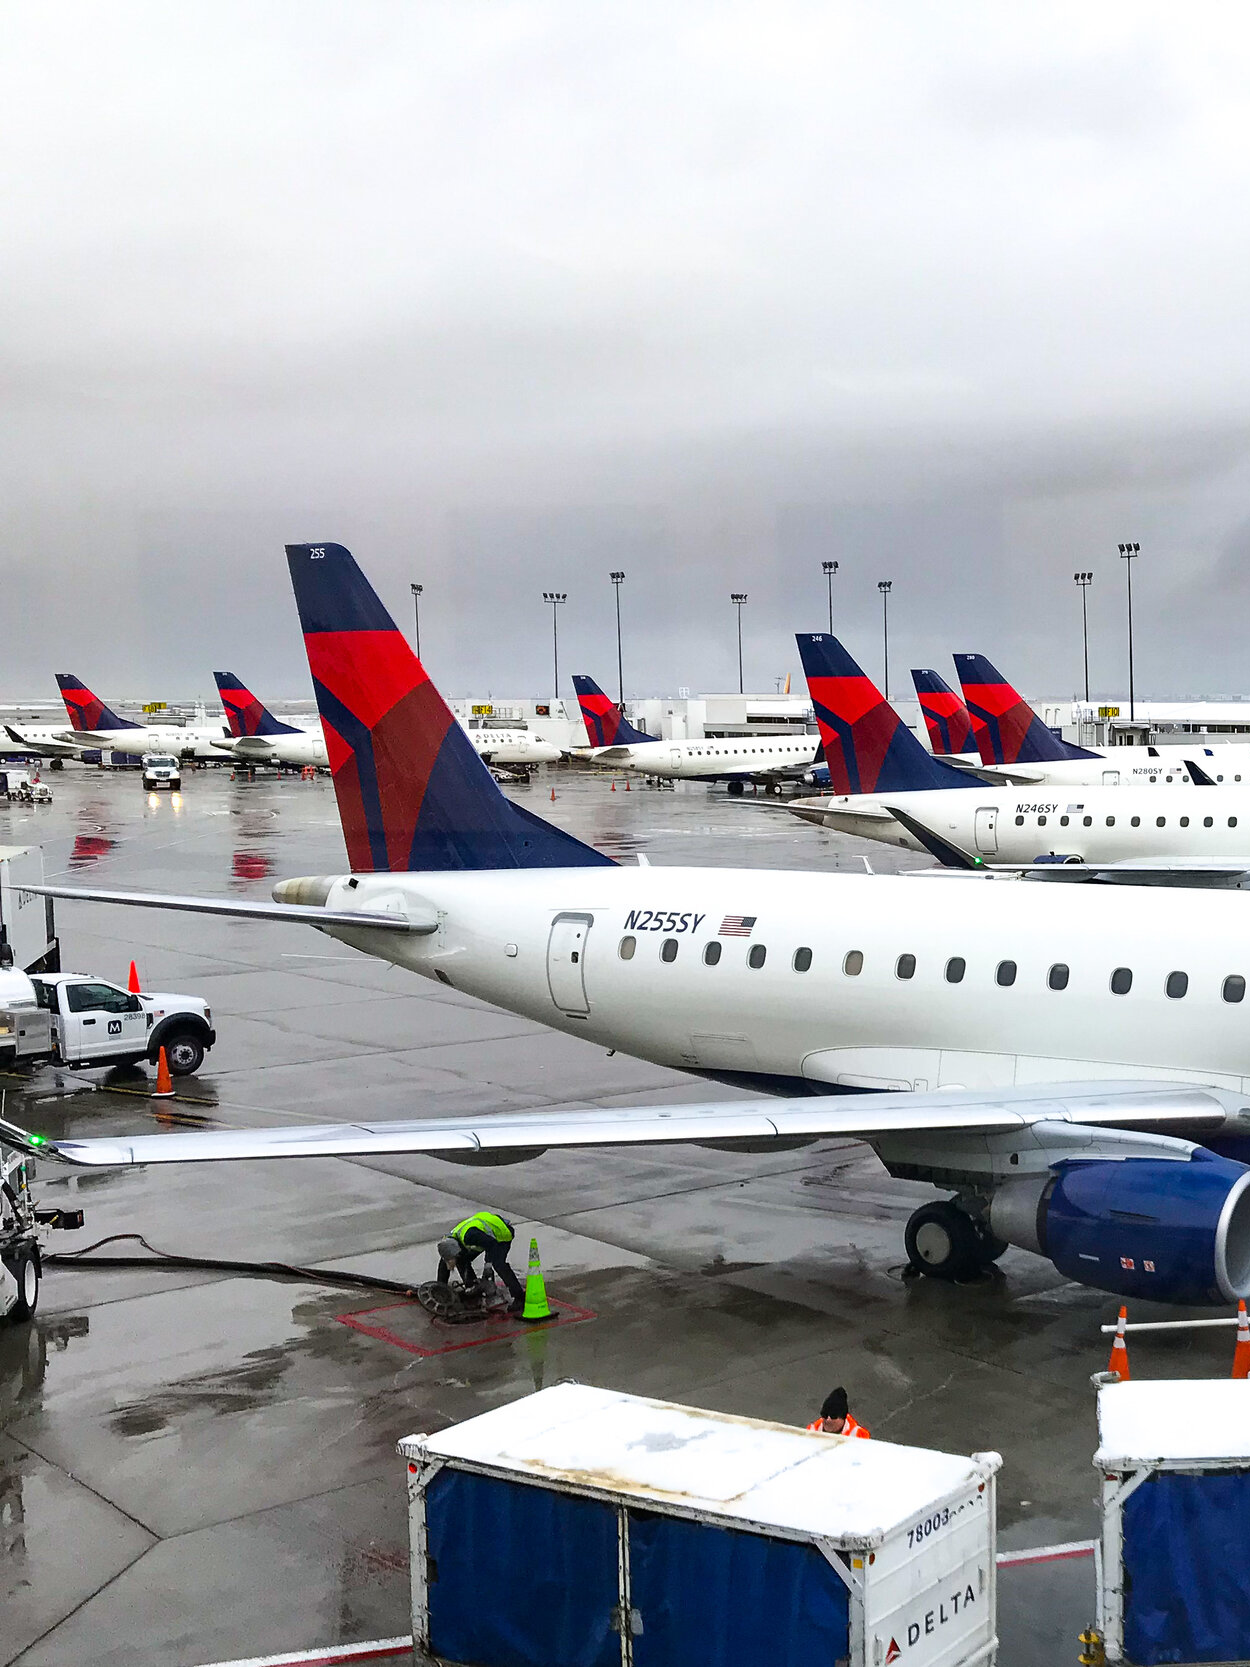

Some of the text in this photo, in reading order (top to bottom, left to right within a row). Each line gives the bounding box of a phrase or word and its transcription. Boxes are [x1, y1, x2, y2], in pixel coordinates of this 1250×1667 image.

[310, 548, 325, 559] 255
[1016, 804, 1058, 813] N246SY
[623, 910, 706, 934] N255SY
[907, 1508, 949, 1549] 78003
[908, 1584, 975, 1646] DELTA
